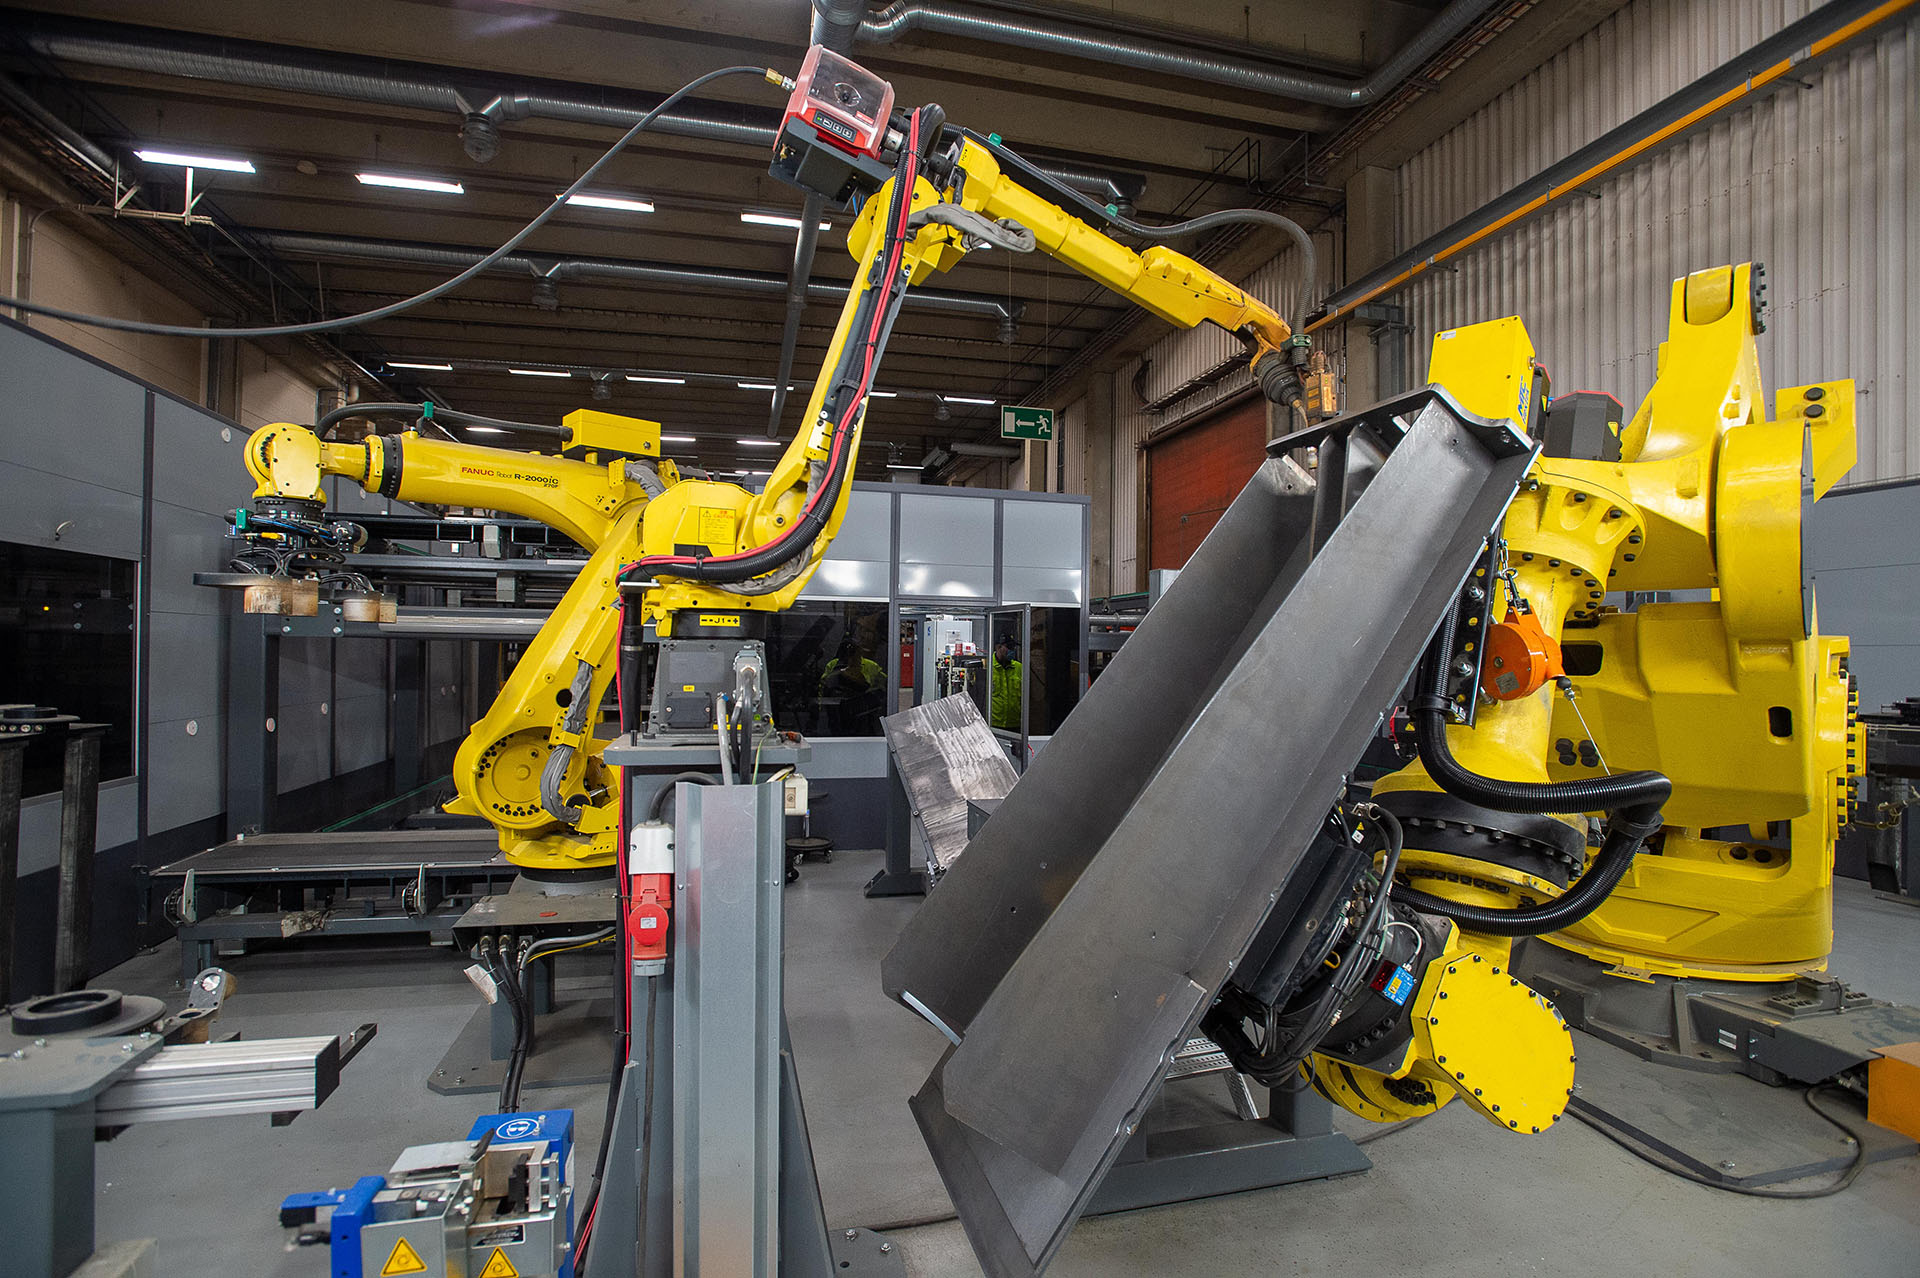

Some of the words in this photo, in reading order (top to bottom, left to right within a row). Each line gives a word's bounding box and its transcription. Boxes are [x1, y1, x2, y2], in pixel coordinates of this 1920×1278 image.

[461, 467, 495, 476] FANUC
[496, 471, 512, 479] Robot
[514, 473, 559, 484] R-2000iC
